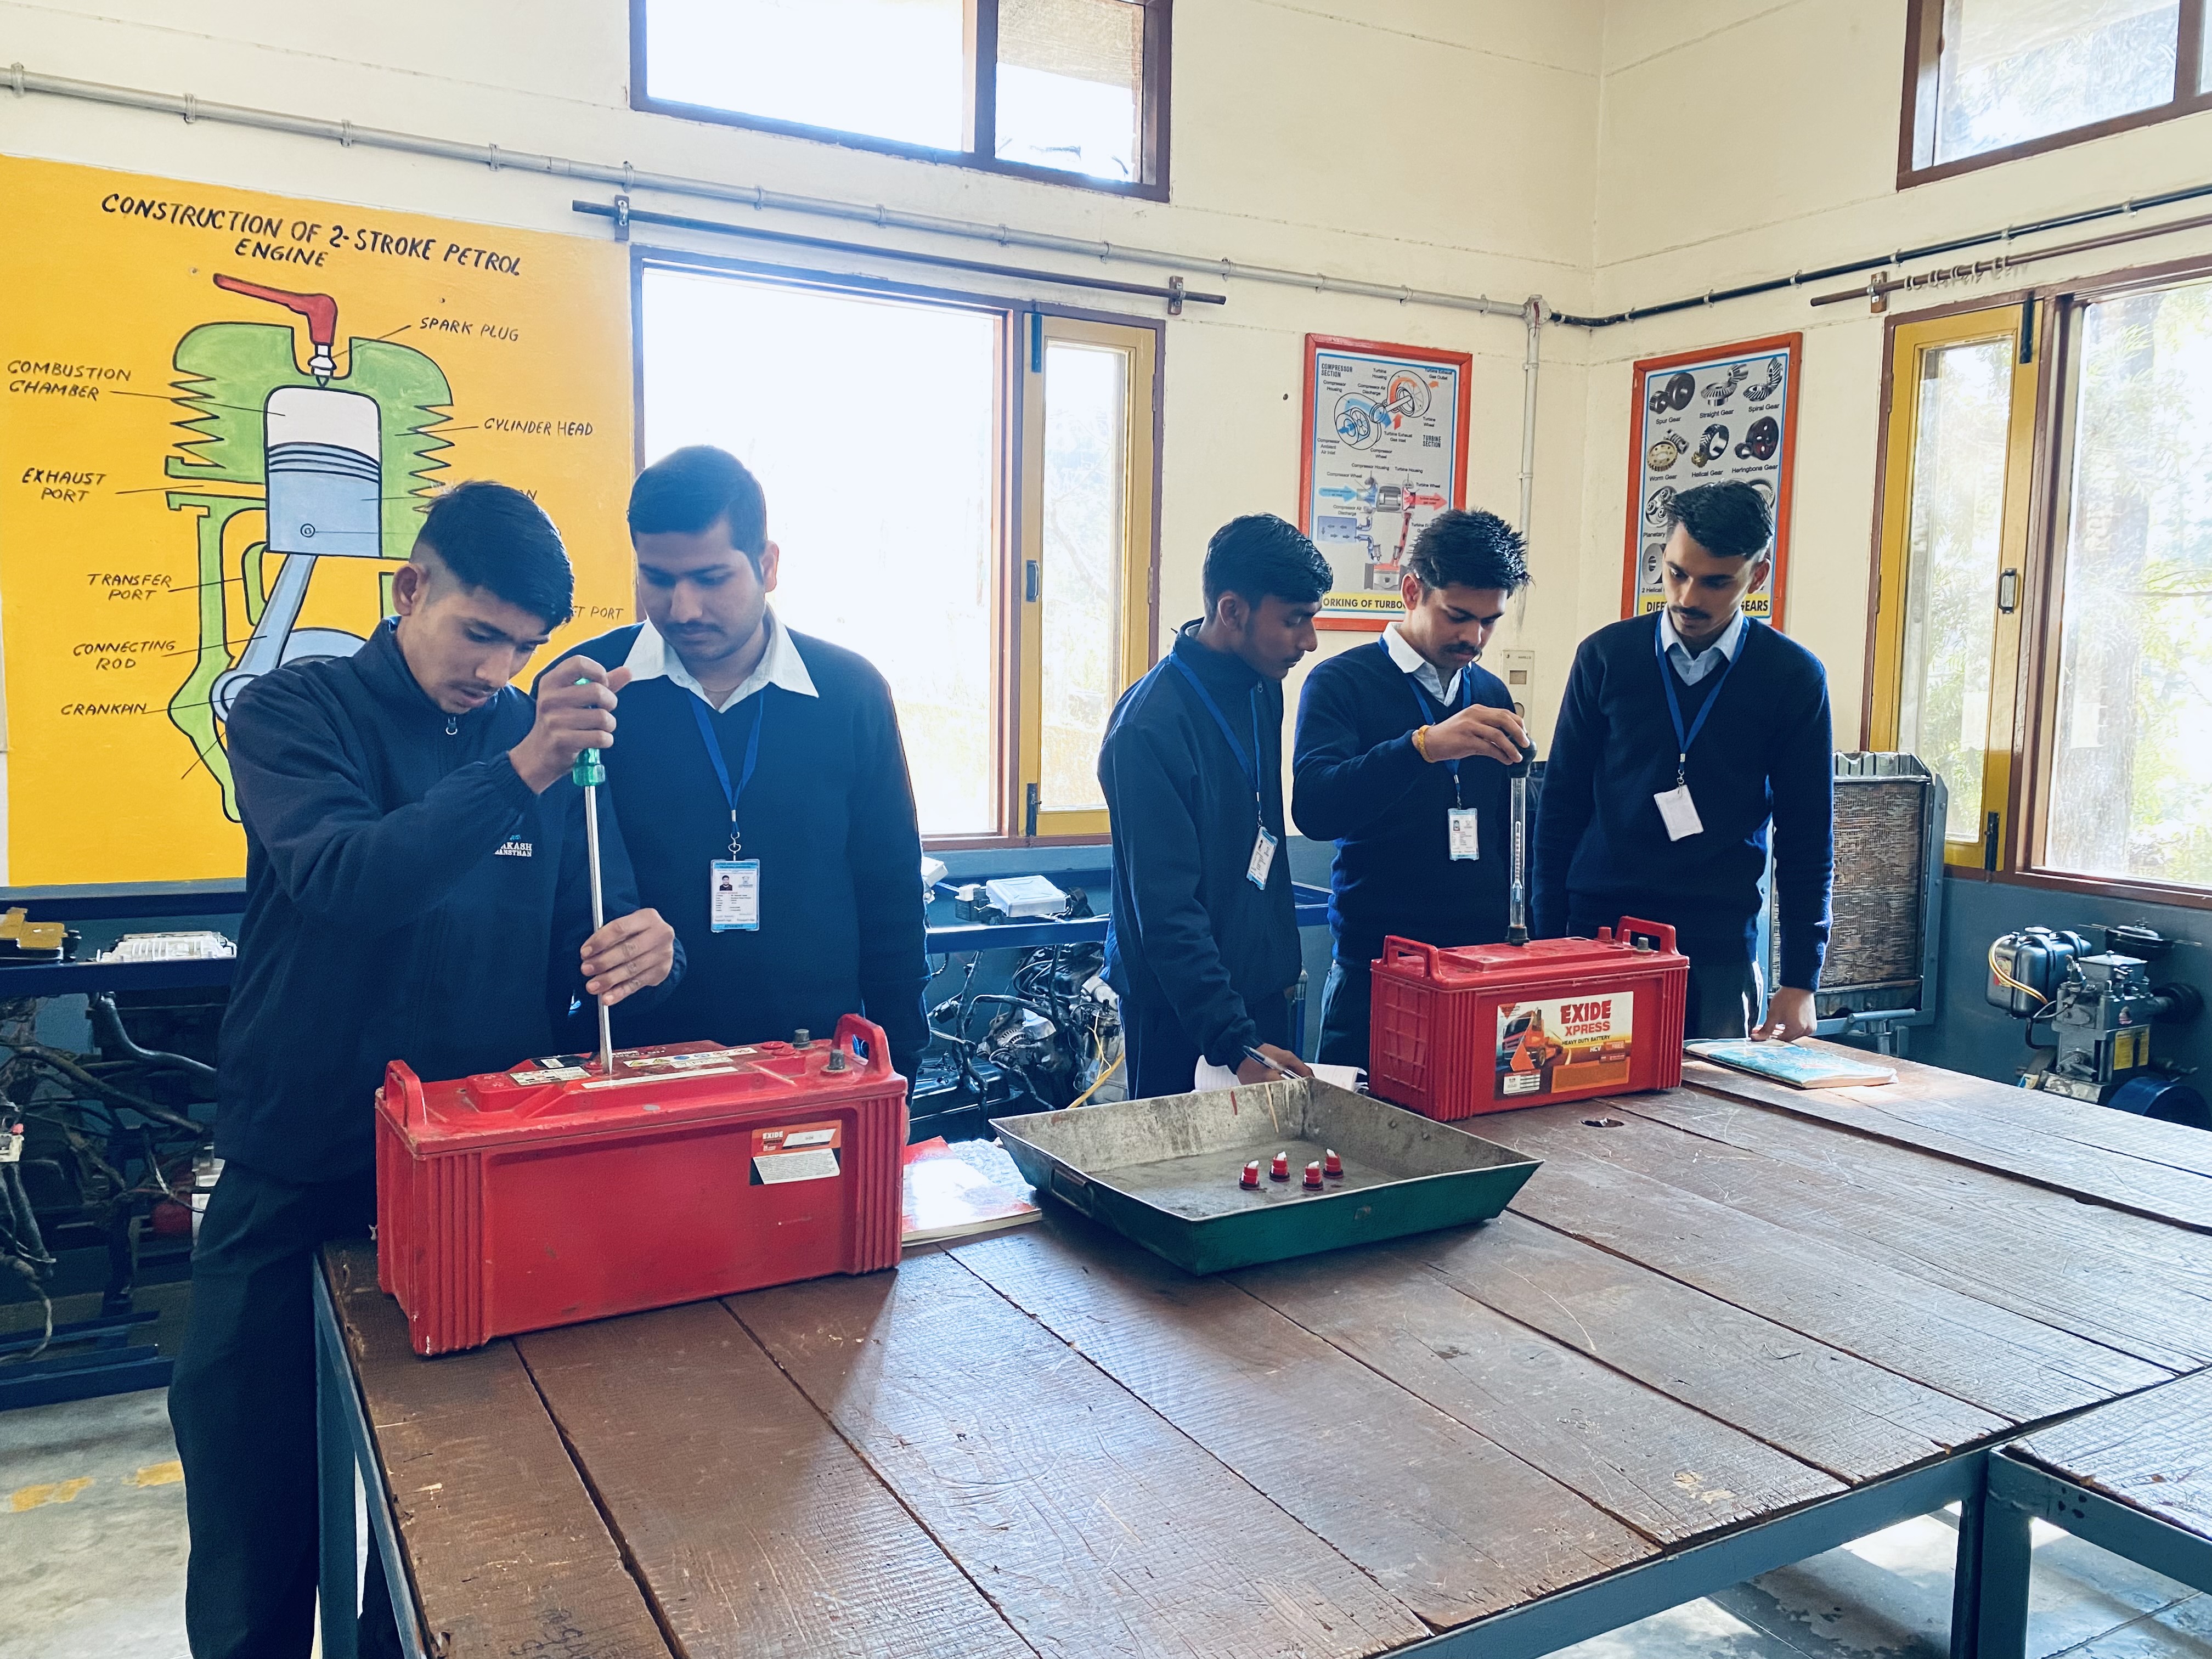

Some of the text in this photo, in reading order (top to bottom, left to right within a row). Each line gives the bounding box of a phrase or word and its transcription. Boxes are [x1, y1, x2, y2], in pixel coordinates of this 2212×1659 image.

[101, 193, 521, 276] CONSTRUCTION OF 2-STROKE PETROL
[235, 238, 329, 267] ENGINE
[419, 317, 518, 342] SPARK PLUG
[7, 360, 131, 383] COMBUSTION
[1321, 363, 1353, 373] COMPRESSOR
[1321, 370, 1341, 378] SECTION
[9, 380, 99, 402] CHAMBER
[1748, 404, 1764, 413] Spiral
[484, 417, 593, 436] CYLINDER HEAD
[21, 467, 107, 486] EXHAUST
[41, 487, 89, 503] PORT
[87, 573, 172, 588] TRANSFER
[108, 588, 157, 601] PORT
[1323, 597, 1406, 609] ORKING OF TURBO
[1646, 601, 1668, 612] DIFF
[590, 606, 624, 620] PORT
[73, 640, 177, 657] CONNECTING
[95, 657, 136, 671] ROD
[1560, 1000, 1612, 1024] EXIDE
[1565, 1021, 1610, 1036] XPRESS
[763, 1131, 783, 1139] EXIDE
